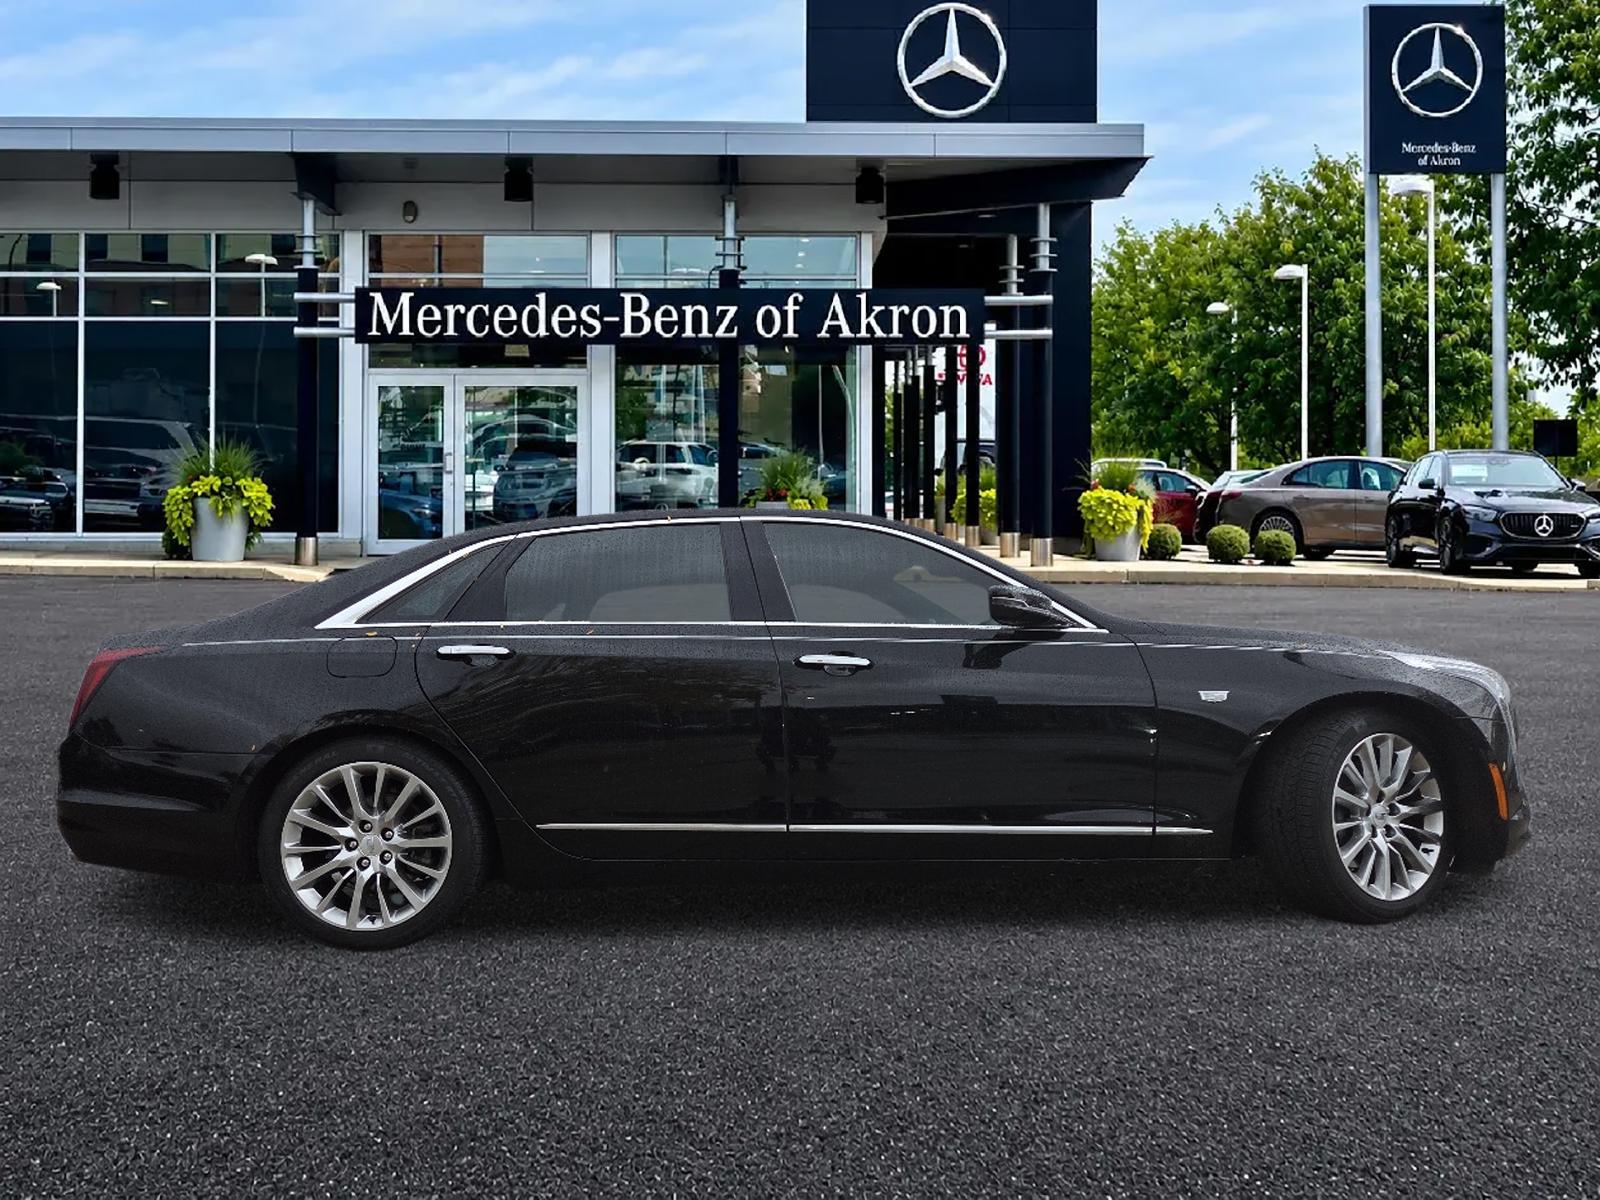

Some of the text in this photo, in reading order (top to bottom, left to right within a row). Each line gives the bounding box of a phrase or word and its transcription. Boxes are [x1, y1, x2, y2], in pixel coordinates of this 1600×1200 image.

[1401, 142, 1476, 153] Mercedes-Benz
[1418, 154, 1461, 166] of Akron
[367, 292, 970, 338] Mercedes-Benz of Akron
